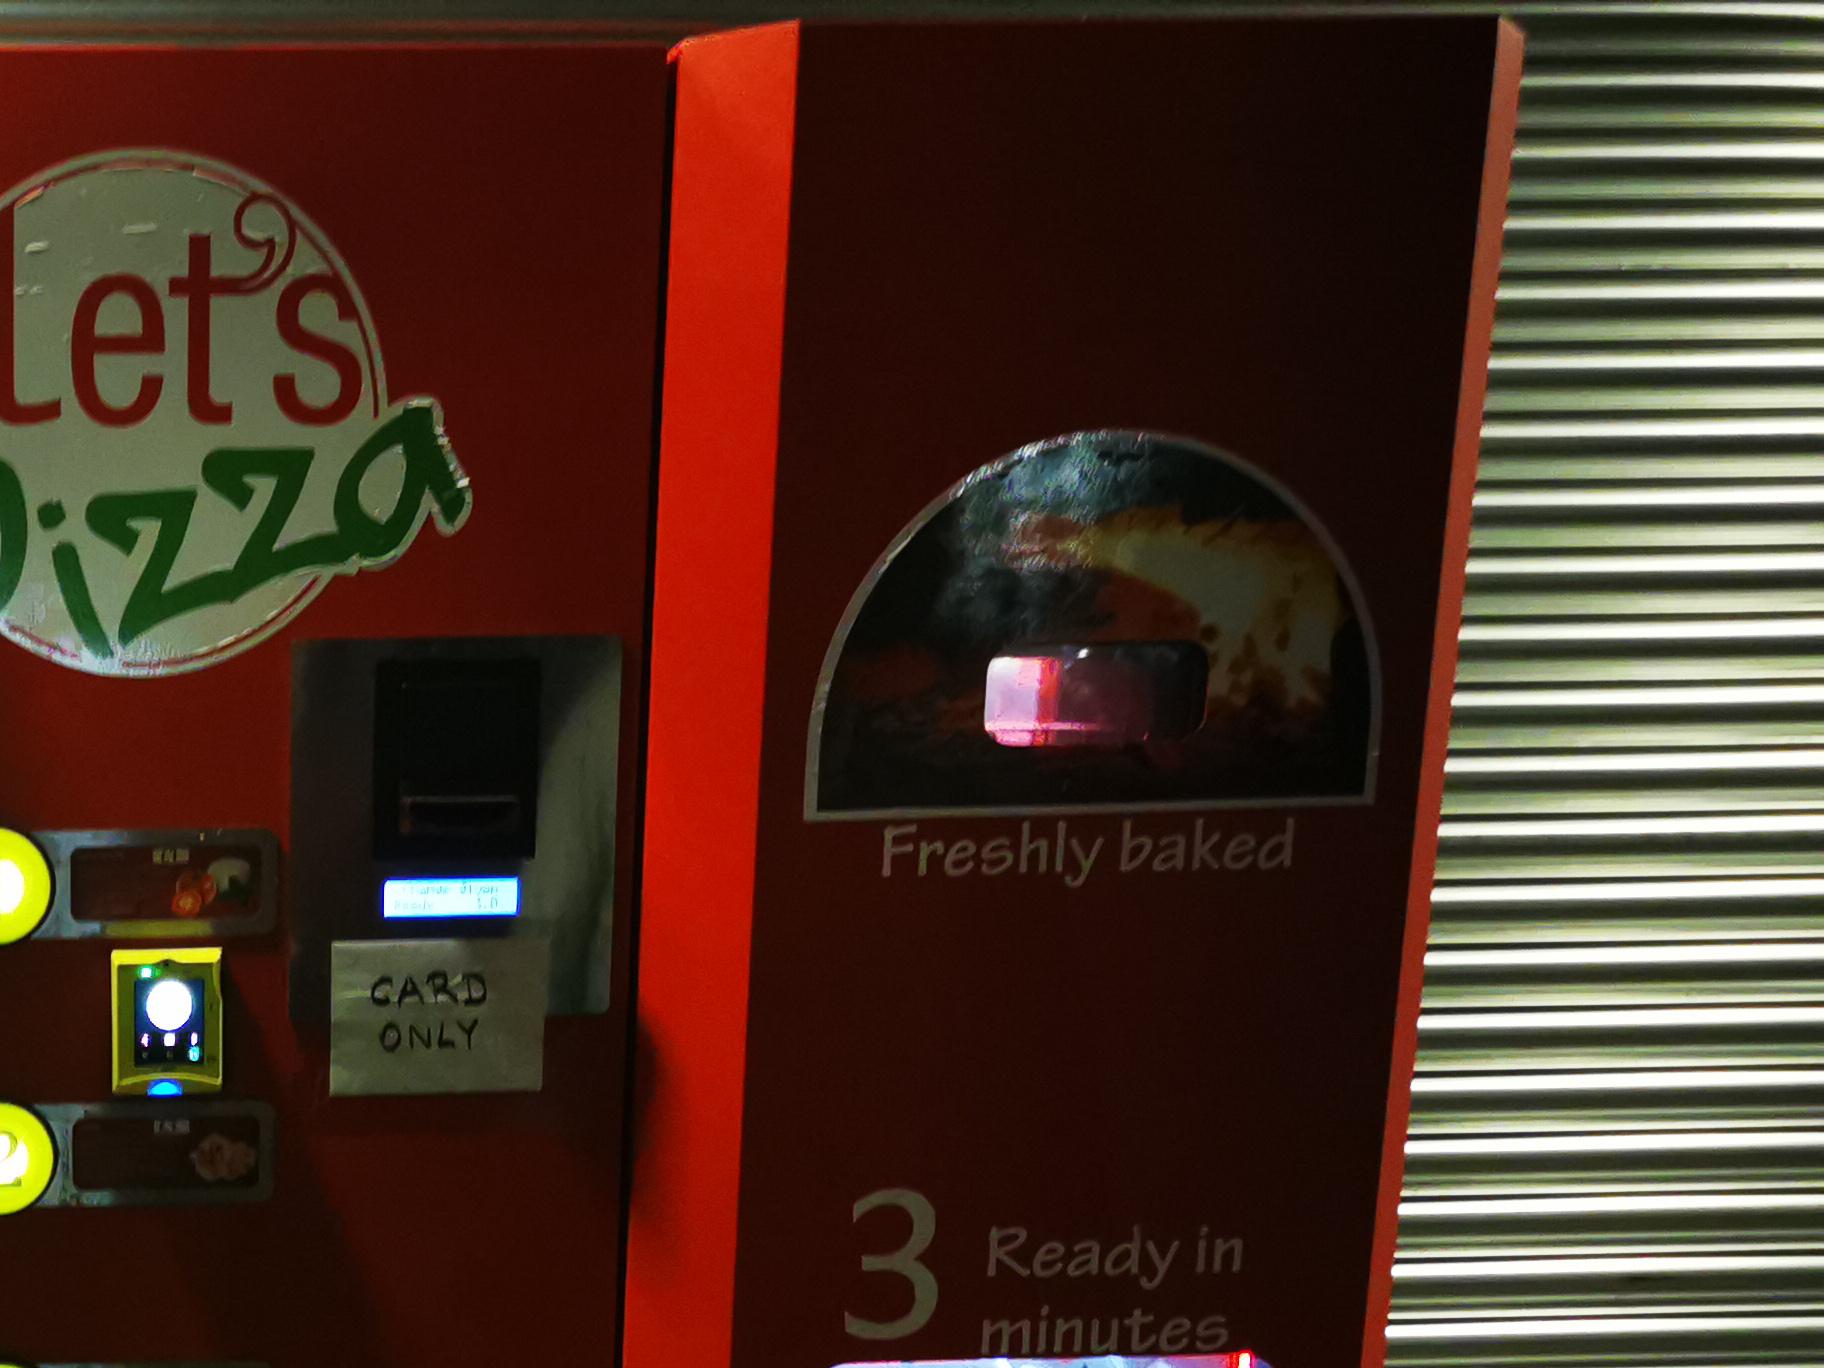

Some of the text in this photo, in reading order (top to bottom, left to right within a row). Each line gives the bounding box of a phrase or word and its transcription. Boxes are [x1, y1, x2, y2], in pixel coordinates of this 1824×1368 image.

[880, 816, 1296, 889] Freshly baked
[370, 968, 488, 1009] CARD
[379, 1017, 479, 1053] ONLY
[843, 1186, 1245, 1342] 3 Ready in
[980, 1304, 1231, 1355] minutes
